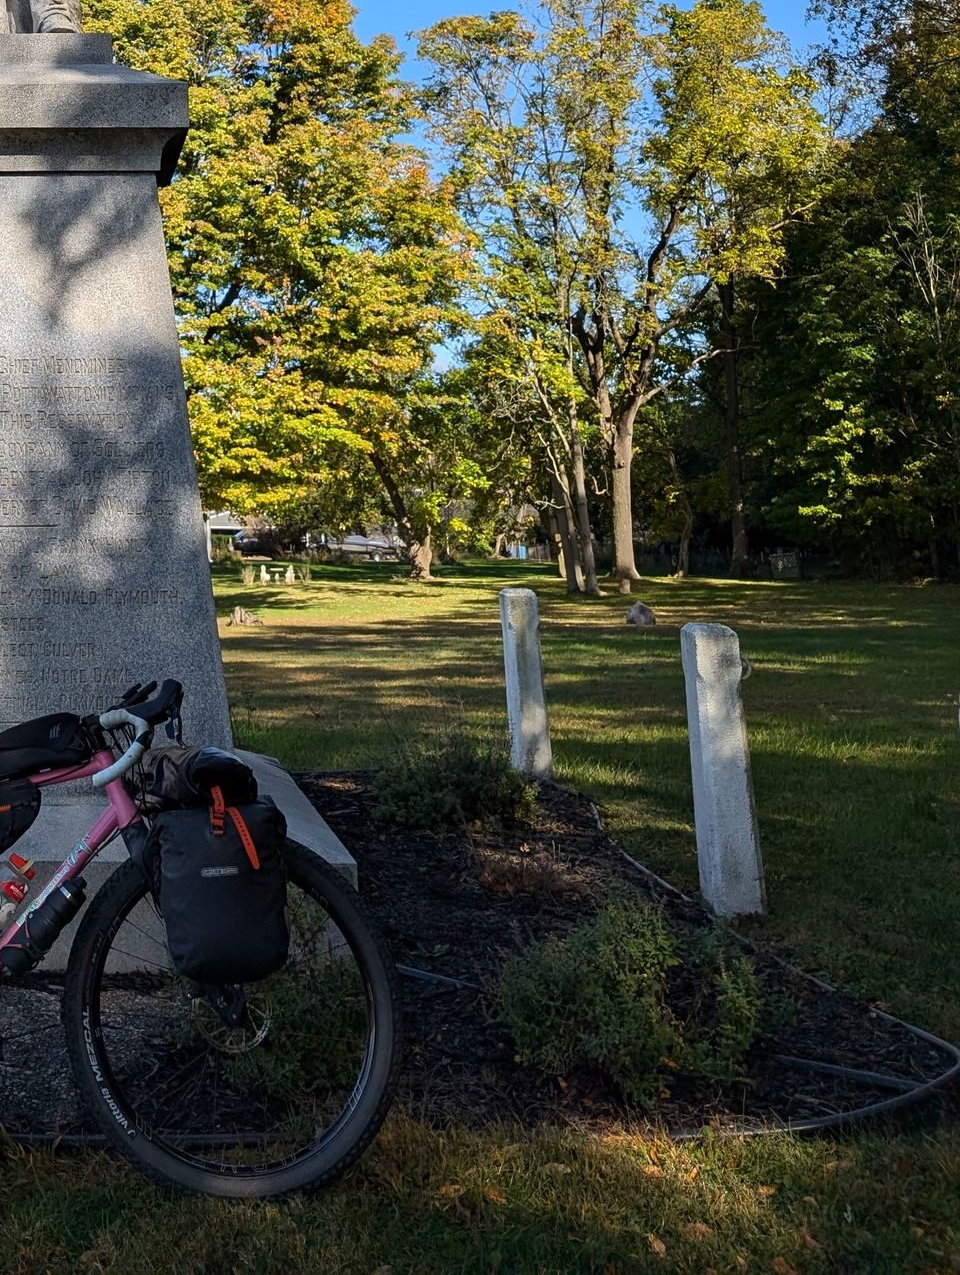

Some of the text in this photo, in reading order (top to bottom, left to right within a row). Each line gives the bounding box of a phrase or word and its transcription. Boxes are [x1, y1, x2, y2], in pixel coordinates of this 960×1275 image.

[41, 355, 127, 375] MENOMINEE
[11, 565, 30, 580] OF
[82, 1005, 104, 1082] MEZCAL
